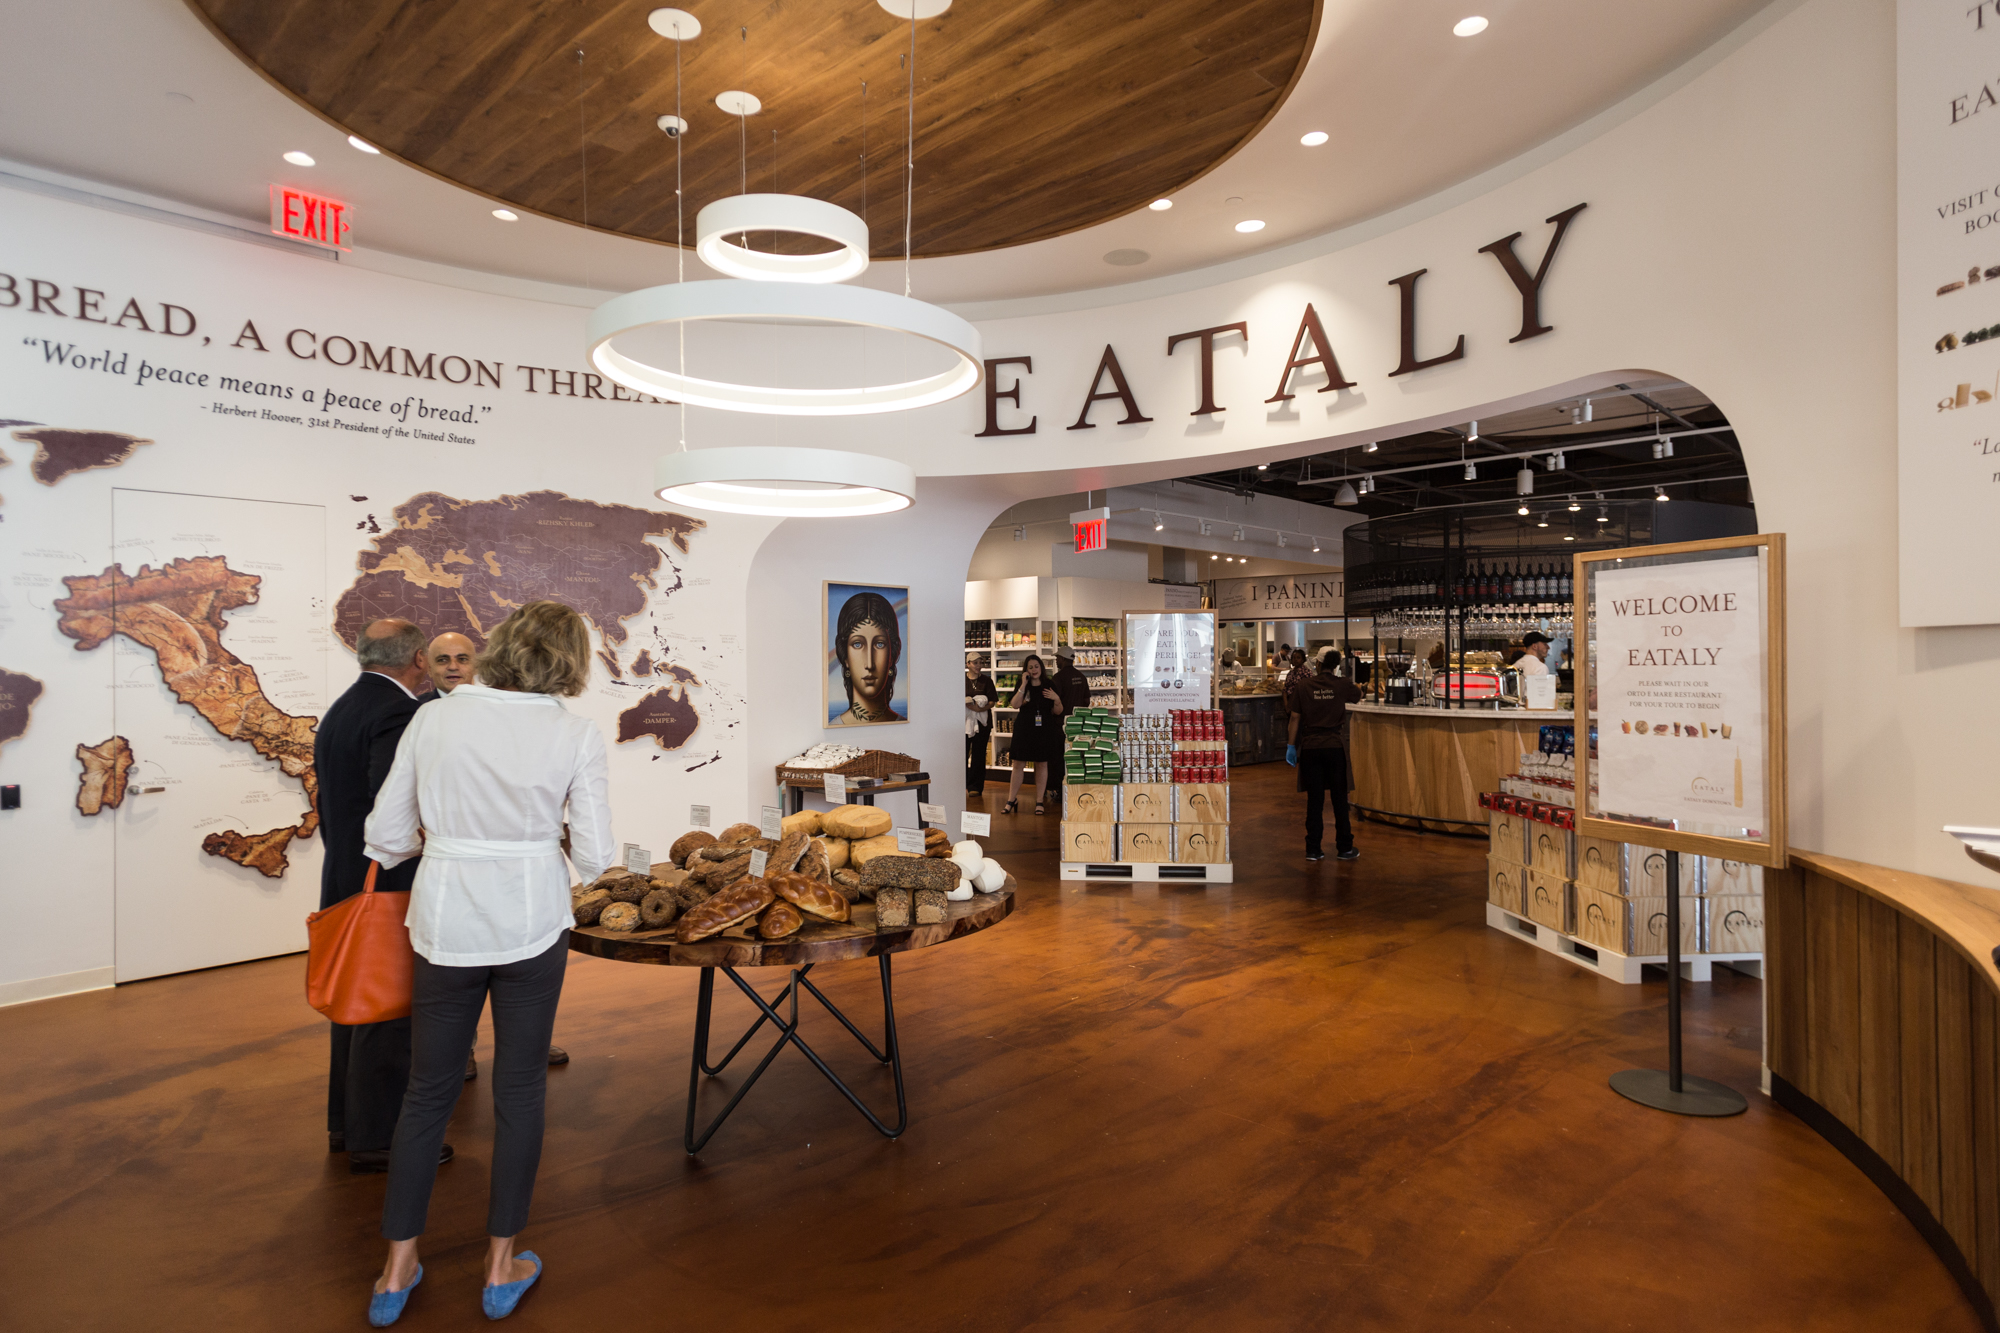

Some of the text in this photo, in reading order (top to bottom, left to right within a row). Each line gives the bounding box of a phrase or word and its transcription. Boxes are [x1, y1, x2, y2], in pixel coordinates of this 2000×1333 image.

[1966, 0, 2000, 32] T
[1948, 77, 2000, 126] EA
[283, 190, 345, 246] EXIT
[1937, 189, 1989, 219] VISIT
[974, 202, 1588, 438] EATALY
[0, 274, 684, 406] BREAD, A COMMON THRE
[136, 359, 210, 387] peace
[219, 376, 294, 400] means
[302, 389, 316, 404] a
[320, 387, 382, 413] peace
[390, 396, 415, 423] of
[212, 402, 257, 418] Herbert
[260, 408, 303, 425] Hoover,
[308, 416, 330, 428] 31st
[333, 418, 379, 434] President
[382, 426, 394, 438] of
[394, 427, 410, 438] the
[414, 428, 444, 442] United
[447, 432, 476, 446] States
[1078, 520, 1102, 550] EXIT
[1252, 582, 1344, 600] I PANINI
[1284, 600, 1330, 609] CIABATTE
[1611, 592, 1738, 617] WELCOME
[1660, 624, 1683, 637] TO
[1627, 647, 1724, 667] EATALY
[1694, 784, 1725, 792] EATALY
